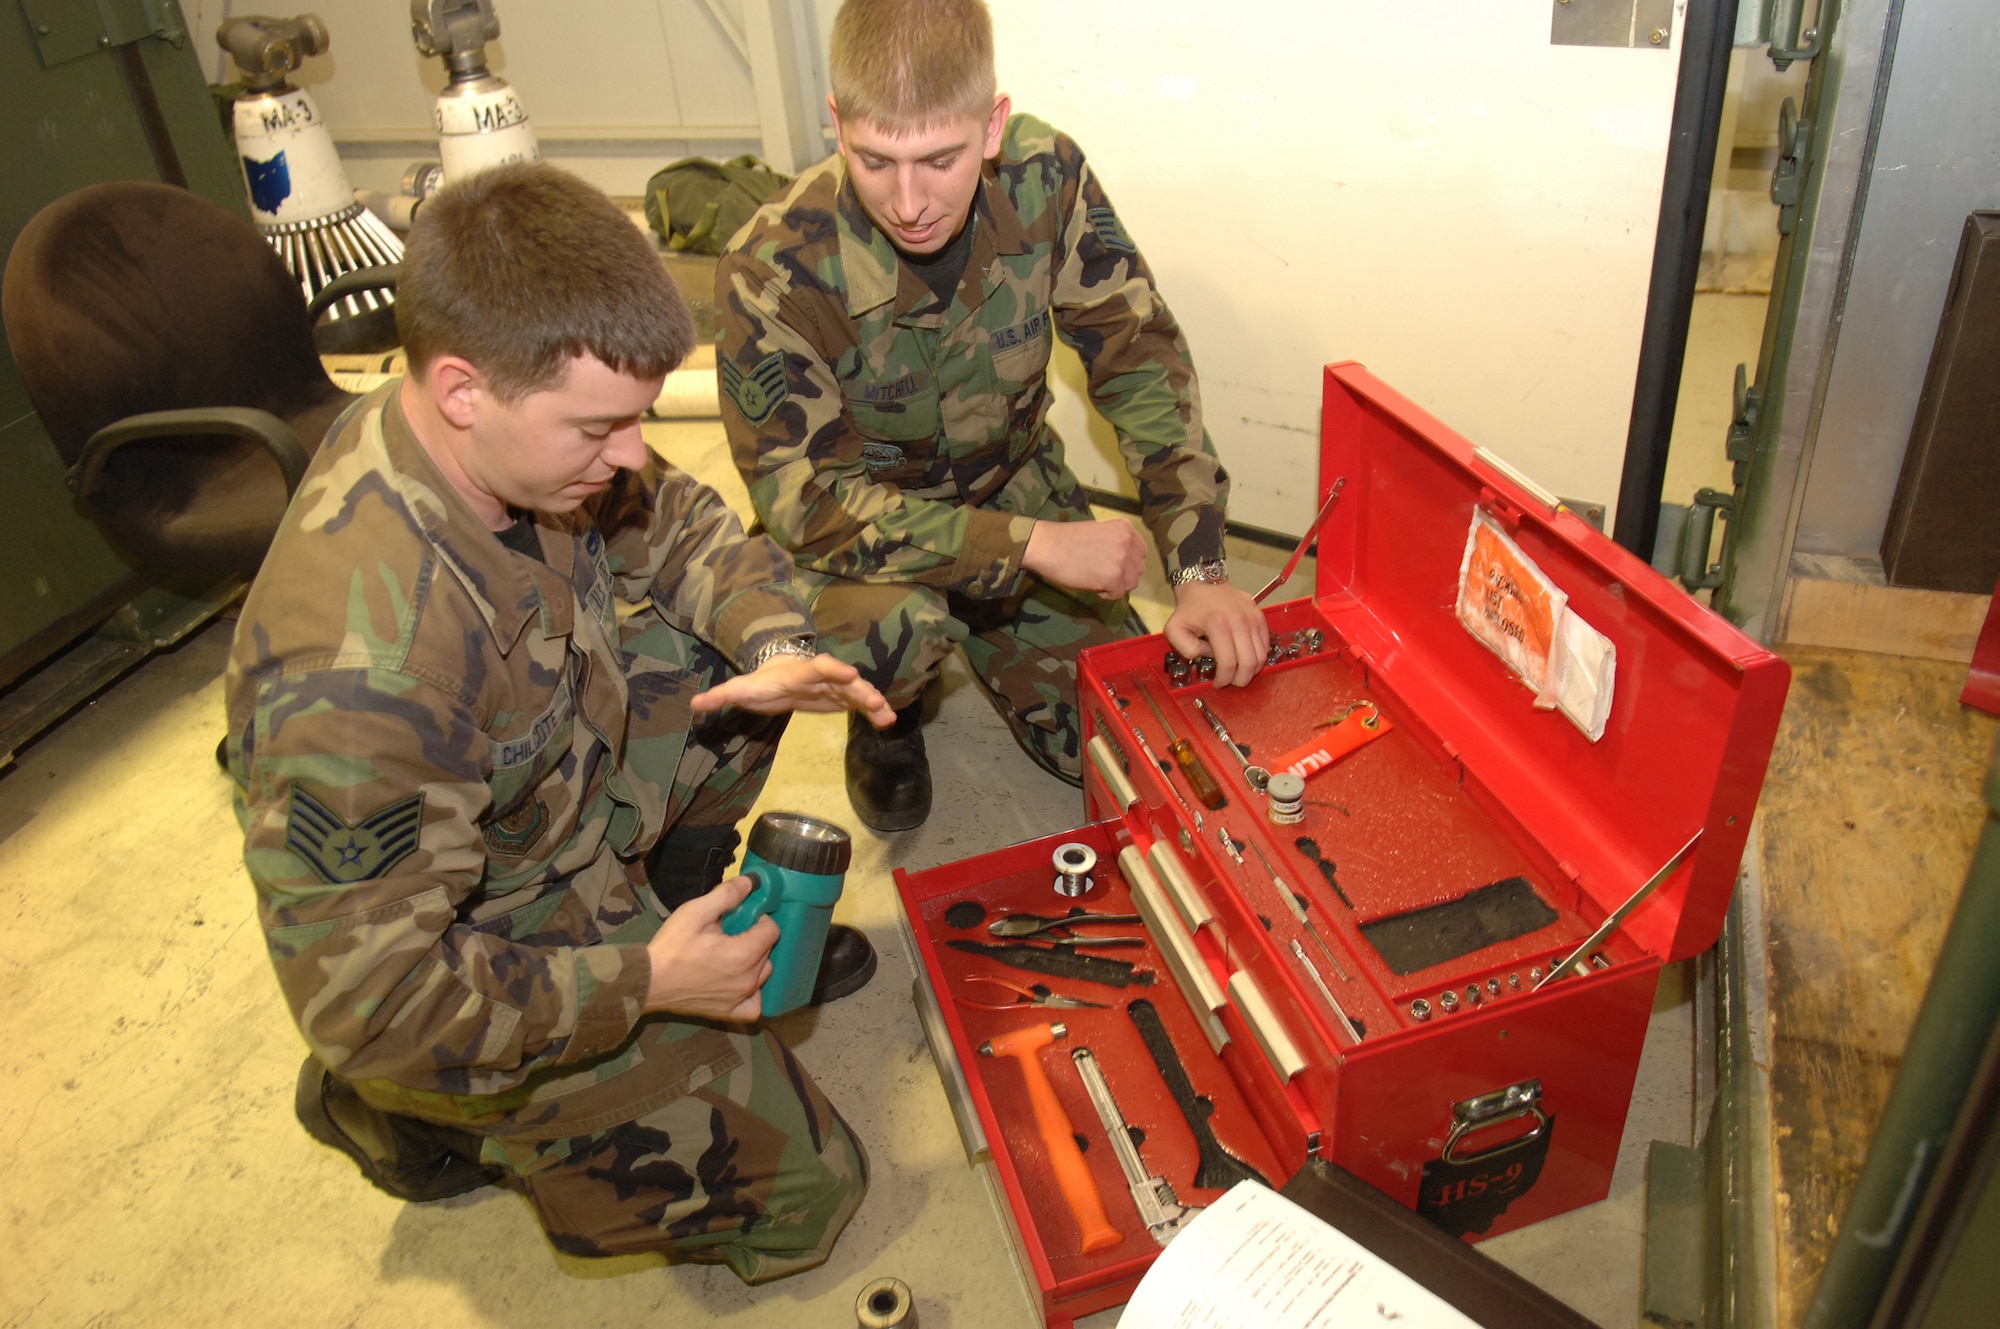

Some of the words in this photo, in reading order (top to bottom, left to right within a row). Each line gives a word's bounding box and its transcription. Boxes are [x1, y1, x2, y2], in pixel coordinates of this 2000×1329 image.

[260, 98, 312, 133] MA-3
[473, 95, 523, 131] MA-3
[995, 329, 1021, 349] U.S.
[1023, 318, 1042, 340] AIR
[864, 377, 919, 401] MITCHELL
[502, 708, 559, 767] CHILCOTE
[1430, 1162, 1523, 1207] HS-9
